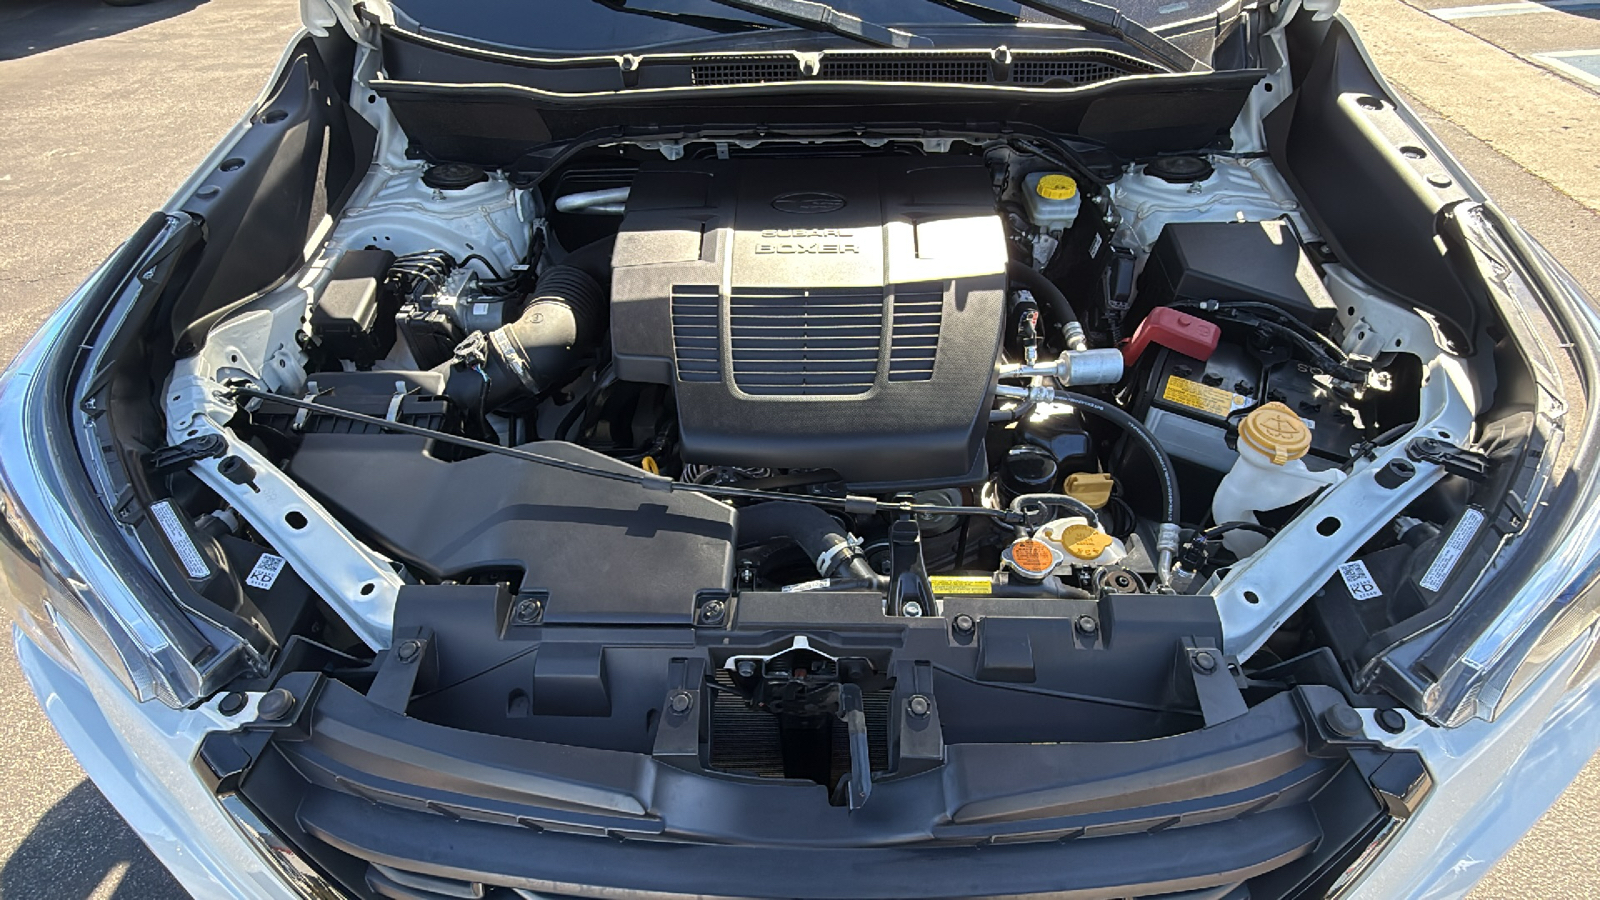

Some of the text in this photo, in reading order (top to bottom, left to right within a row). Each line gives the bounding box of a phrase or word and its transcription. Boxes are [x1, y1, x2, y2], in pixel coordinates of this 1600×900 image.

[755, 243, 860, 254] BOXER
[250, 571, 272, 583] KD
[1351, 584, 1374, 595] KD
